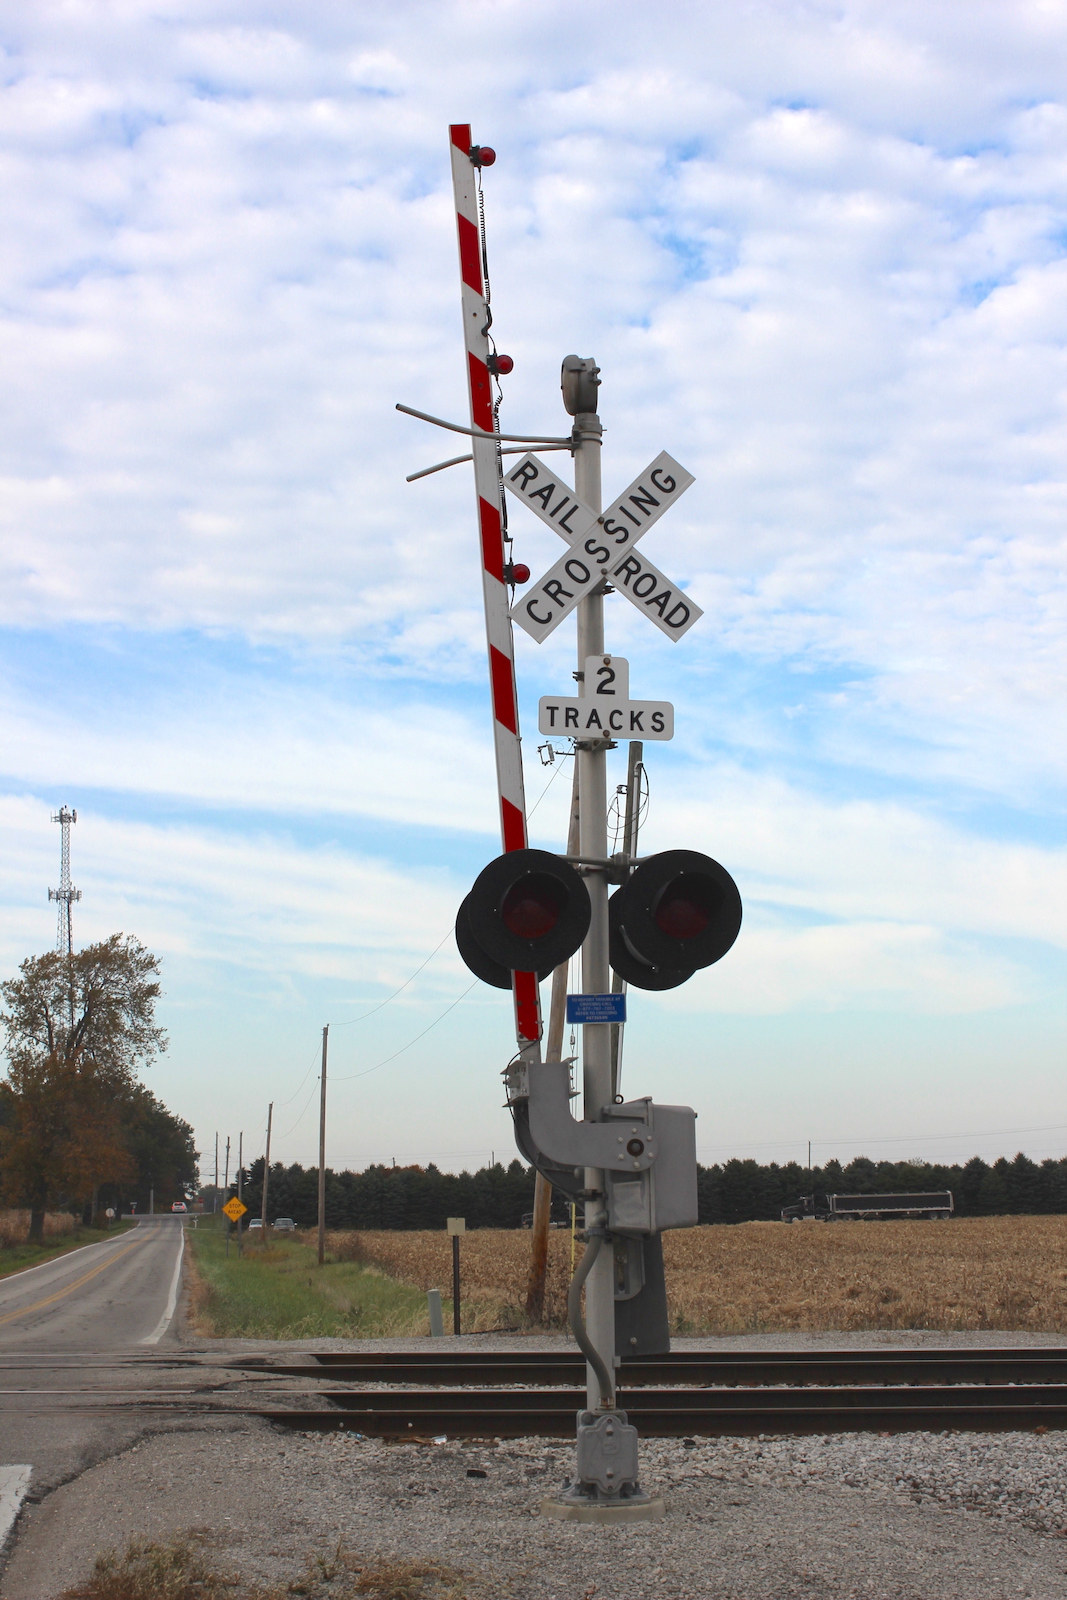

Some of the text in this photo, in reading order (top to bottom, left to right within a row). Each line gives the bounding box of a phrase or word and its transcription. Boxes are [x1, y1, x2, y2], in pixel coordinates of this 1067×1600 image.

[510, 460, 579, 534] RAIL
[526, 469, 677, 625] CROSSING
[613, 555, 690, 629] ROAD
[596, 666, 616, 695] 2
[546, 706, 665, 732] TRACKS
